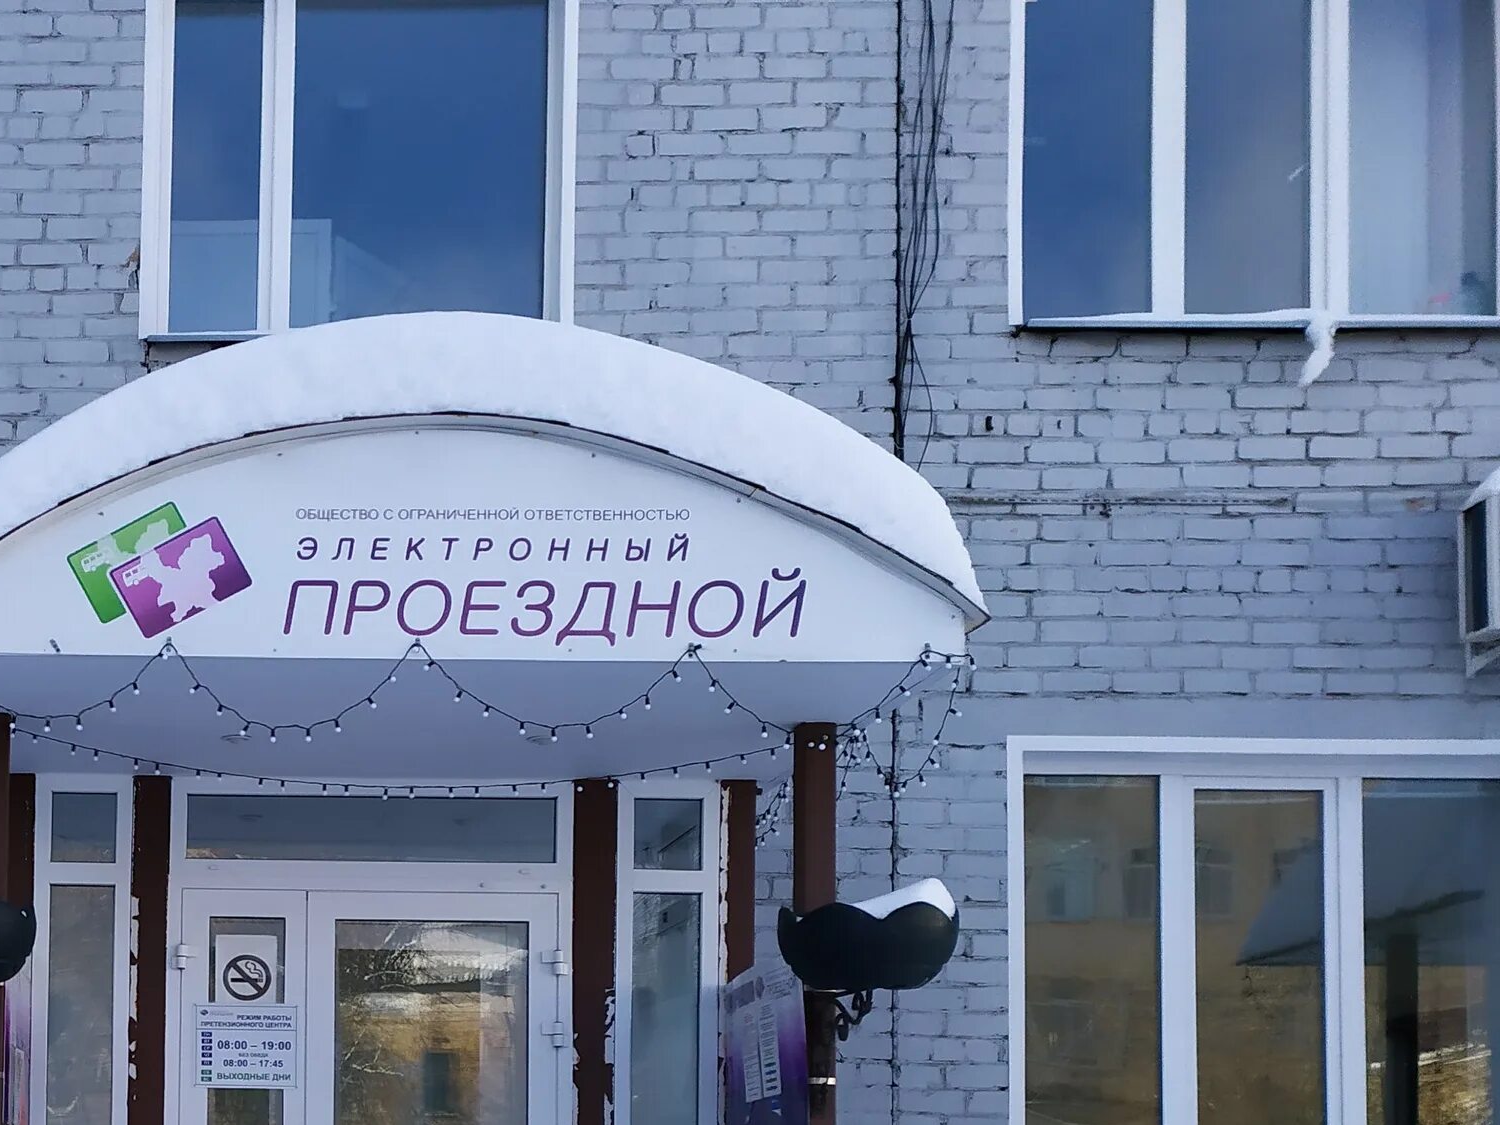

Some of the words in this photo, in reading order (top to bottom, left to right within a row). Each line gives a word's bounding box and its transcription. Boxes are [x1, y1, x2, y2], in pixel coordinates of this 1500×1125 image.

[295, 508, 379, 522] ОБЩЕСТВО
[383, 508, 394, 521] С
[397, 507, 520, 521] ОГРАНИЧЕННОЙ
[524, 508, 691, 521] ОТВЕТСТВЕННОСТЬЮ
[296, 533, 690, 562] ЭЛЕКТРОННЫЙ
[283, 567, 807, 646] ПРОЕЗДНОЙ
[217, 1040, 248, 1050] 08:00
[261, 1041, 292, 1051] 19:00
[223, 1059, 248, 1067] 08:00
[259, 1060, 284, 1068] 17:45
[217, 1073, 270, 1081] ВЫХОДНЫЕ
